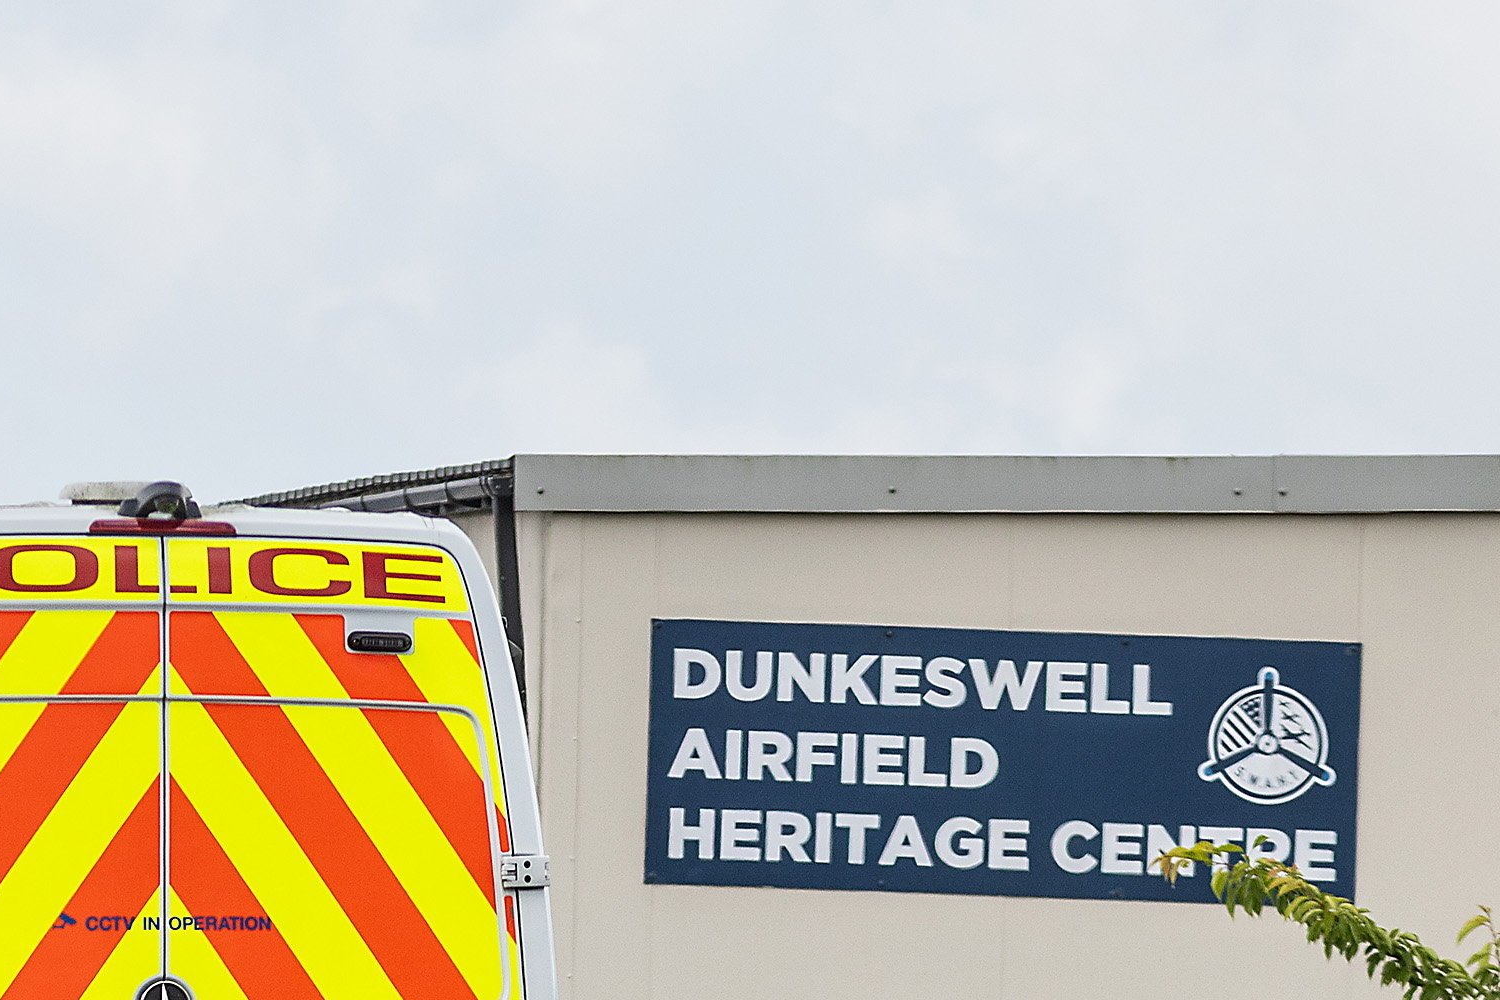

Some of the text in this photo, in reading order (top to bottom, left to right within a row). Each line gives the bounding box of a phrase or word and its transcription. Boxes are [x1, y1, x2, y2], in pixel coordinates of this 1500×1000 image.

[672, 648, 1173, 716] DUNKESWELL
[667, 728, 1000, 789] AIRFIELD
[667, 807, 1031, 871] HERITAGE
[85, 916, 273, 932] CCTV IN OPERATION
